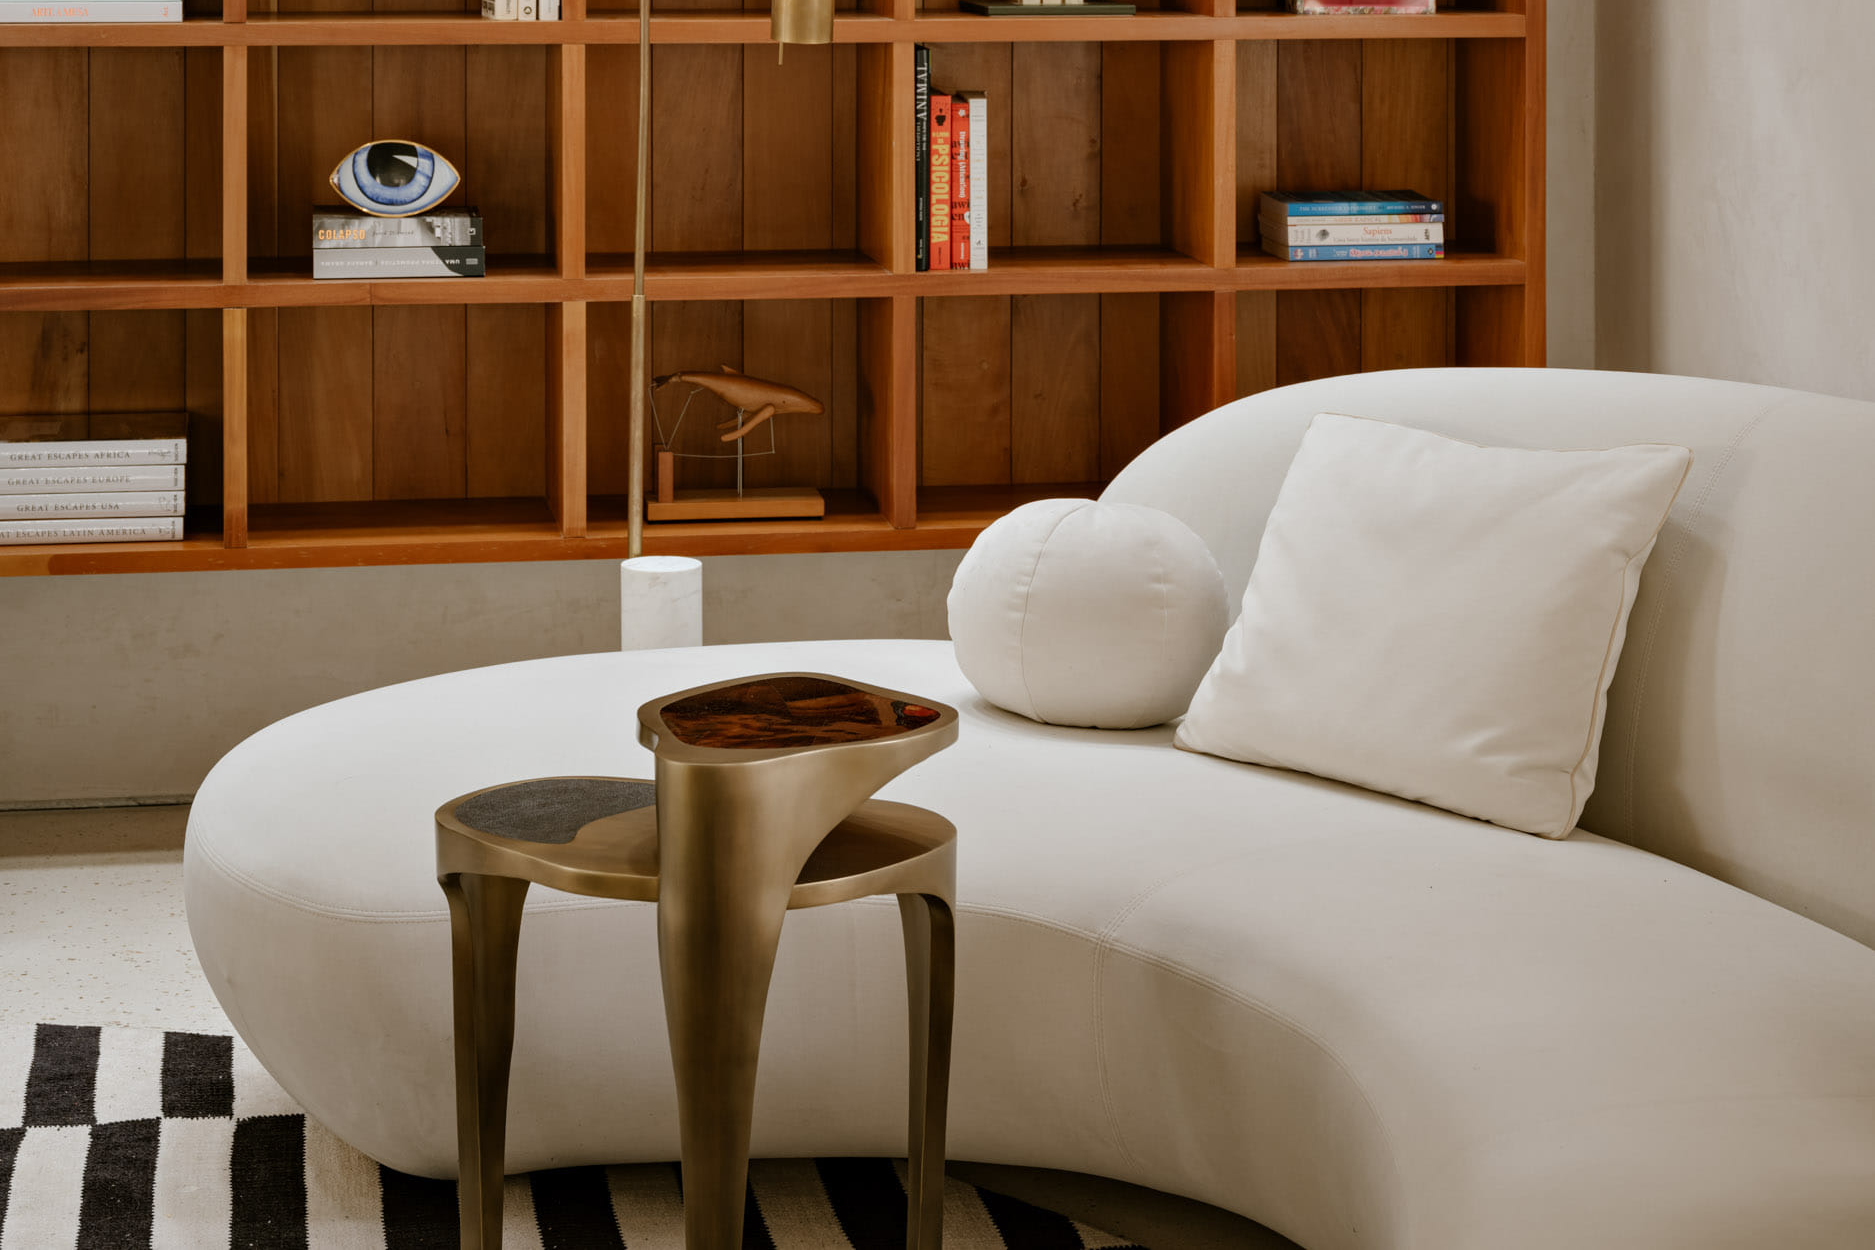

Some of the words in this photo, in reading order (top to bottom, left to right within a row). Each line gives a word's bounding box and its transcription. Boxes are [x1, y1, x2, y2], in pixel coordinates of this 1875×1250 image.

[916, 63, 928, 121] ANIMAL
[931, 144, 950, 244] PSICOLOGIA
[318, 229, 366, 241] COLAPSO
[1362, 226, 1393, 238] Sapiens
[10, 453, 43, 462] GREAT
[47, 452, 90, 461] ESCAPES
[93, 451, 131, 460] AFRICA
[7, 478, 41, 486] GREAT
[45, 477, 88, 485] ESCAPES
[92, 475, 132, 484] EUROPE
[16, 504, 49, 512] GREAT
[54, 503, 97, 512] ESCAPES
[16, 530, 58, 538] ESCAPES
[63, 529, 94, 538] LATIN
[98, 528, 147, 537] AMERICA
